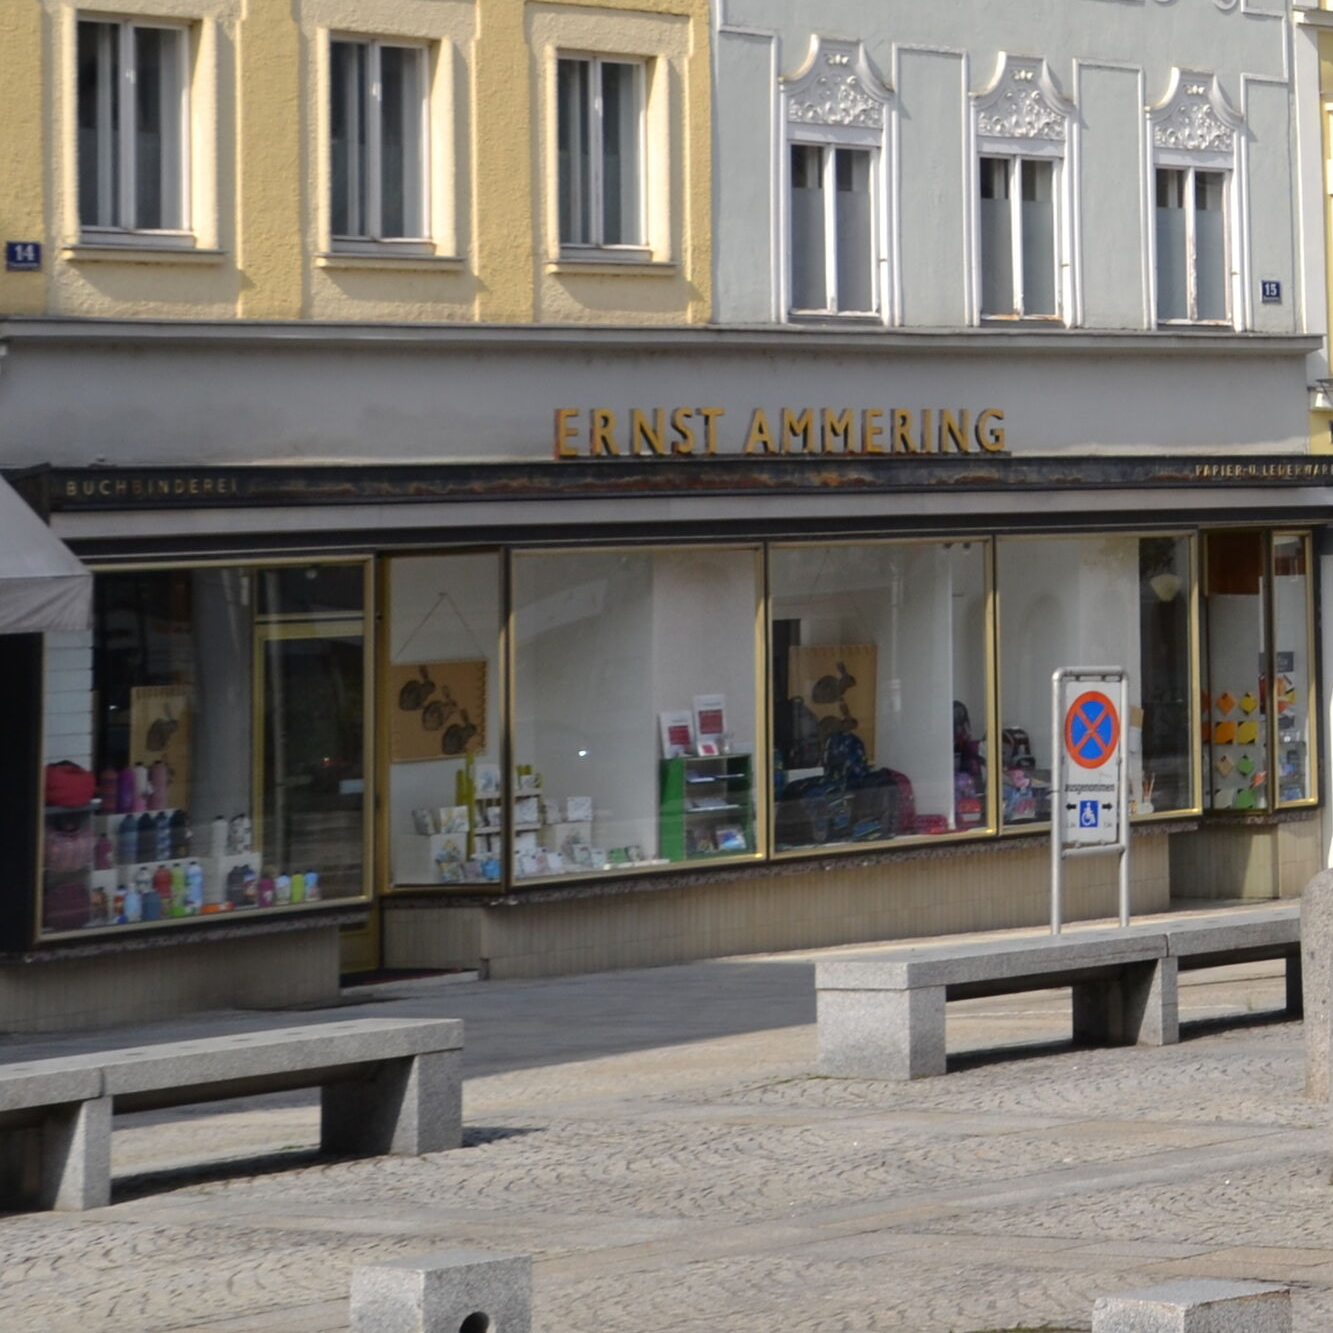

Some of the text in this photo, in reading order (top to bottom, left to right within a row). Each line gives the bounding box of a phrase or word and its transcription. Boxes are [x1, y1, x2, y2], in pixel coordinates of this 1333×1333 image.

[15, 245, 35, 261] 14
[1264, 283, 1277, 296] 15
[553, 408, 1007, 459] ERNST AMMERING
[66, 478, 238, 496] BUCHBINDEREI
